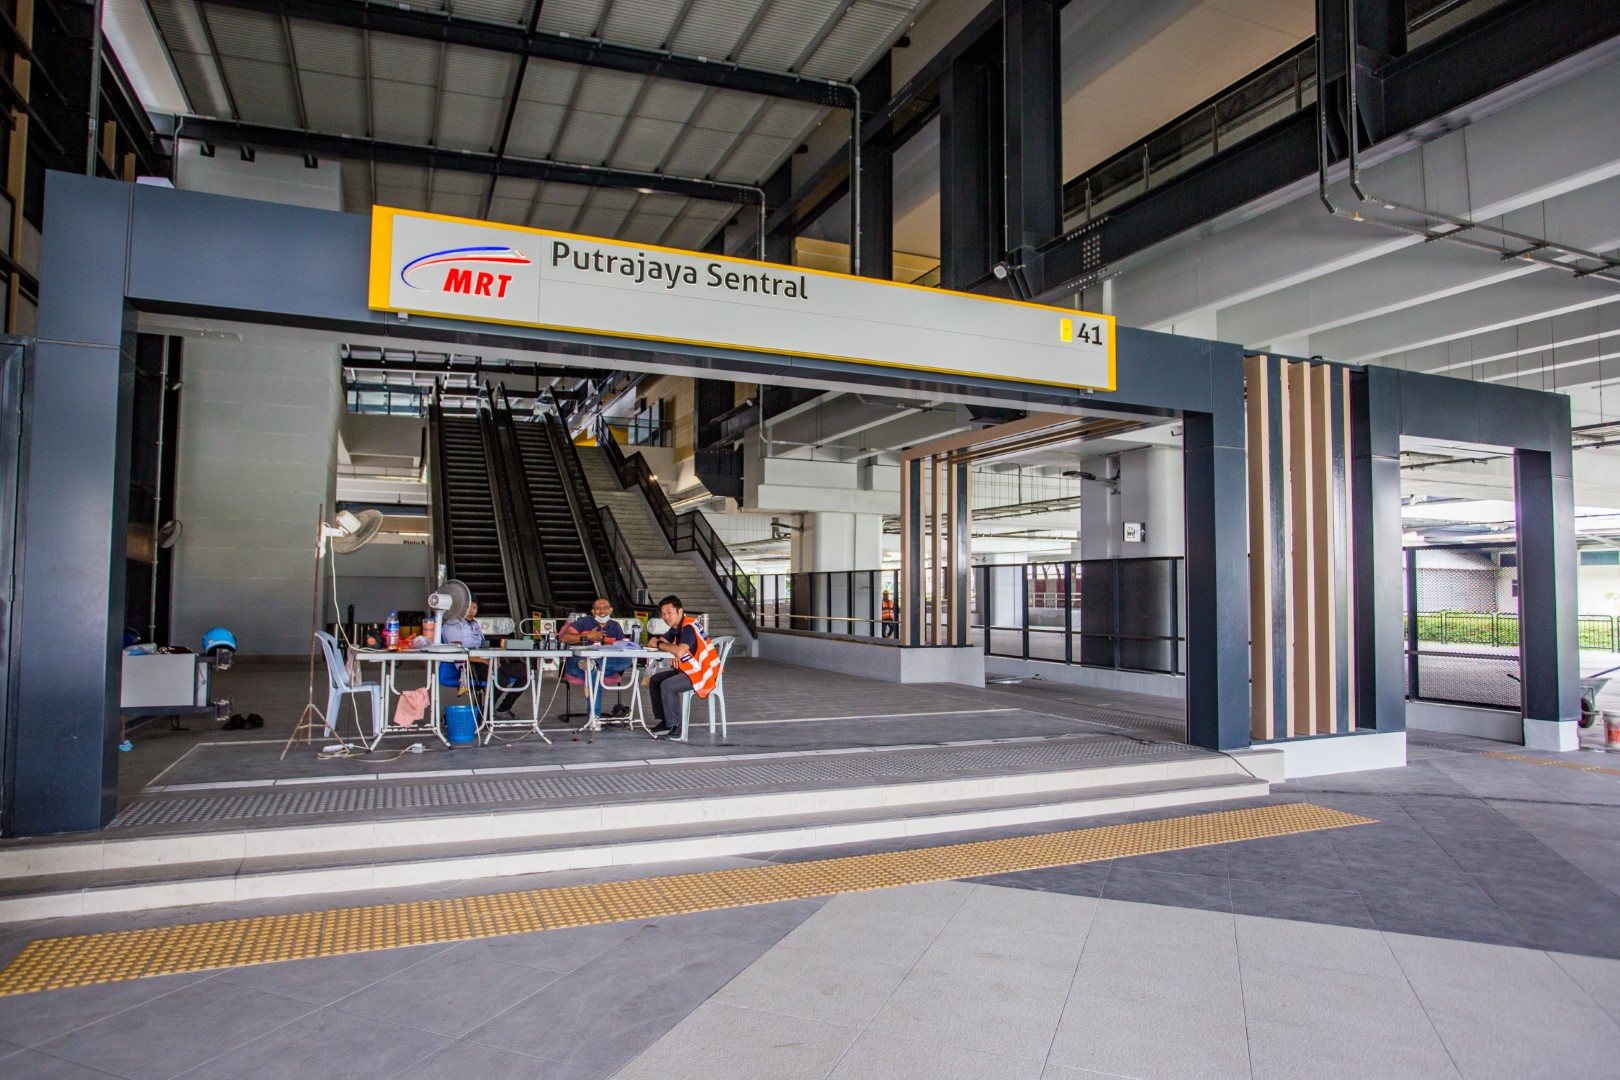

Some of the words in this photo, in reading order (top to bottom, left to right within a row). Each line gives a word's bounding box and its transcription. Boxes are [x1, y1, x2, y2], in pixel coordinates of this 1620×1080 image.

[443, 267, 513, 299] MRT
[552, 241, 698, 289] Putrajaya
[706, 263, 808, 299] Sentral
[1077, 322, 1103, 346] 41
